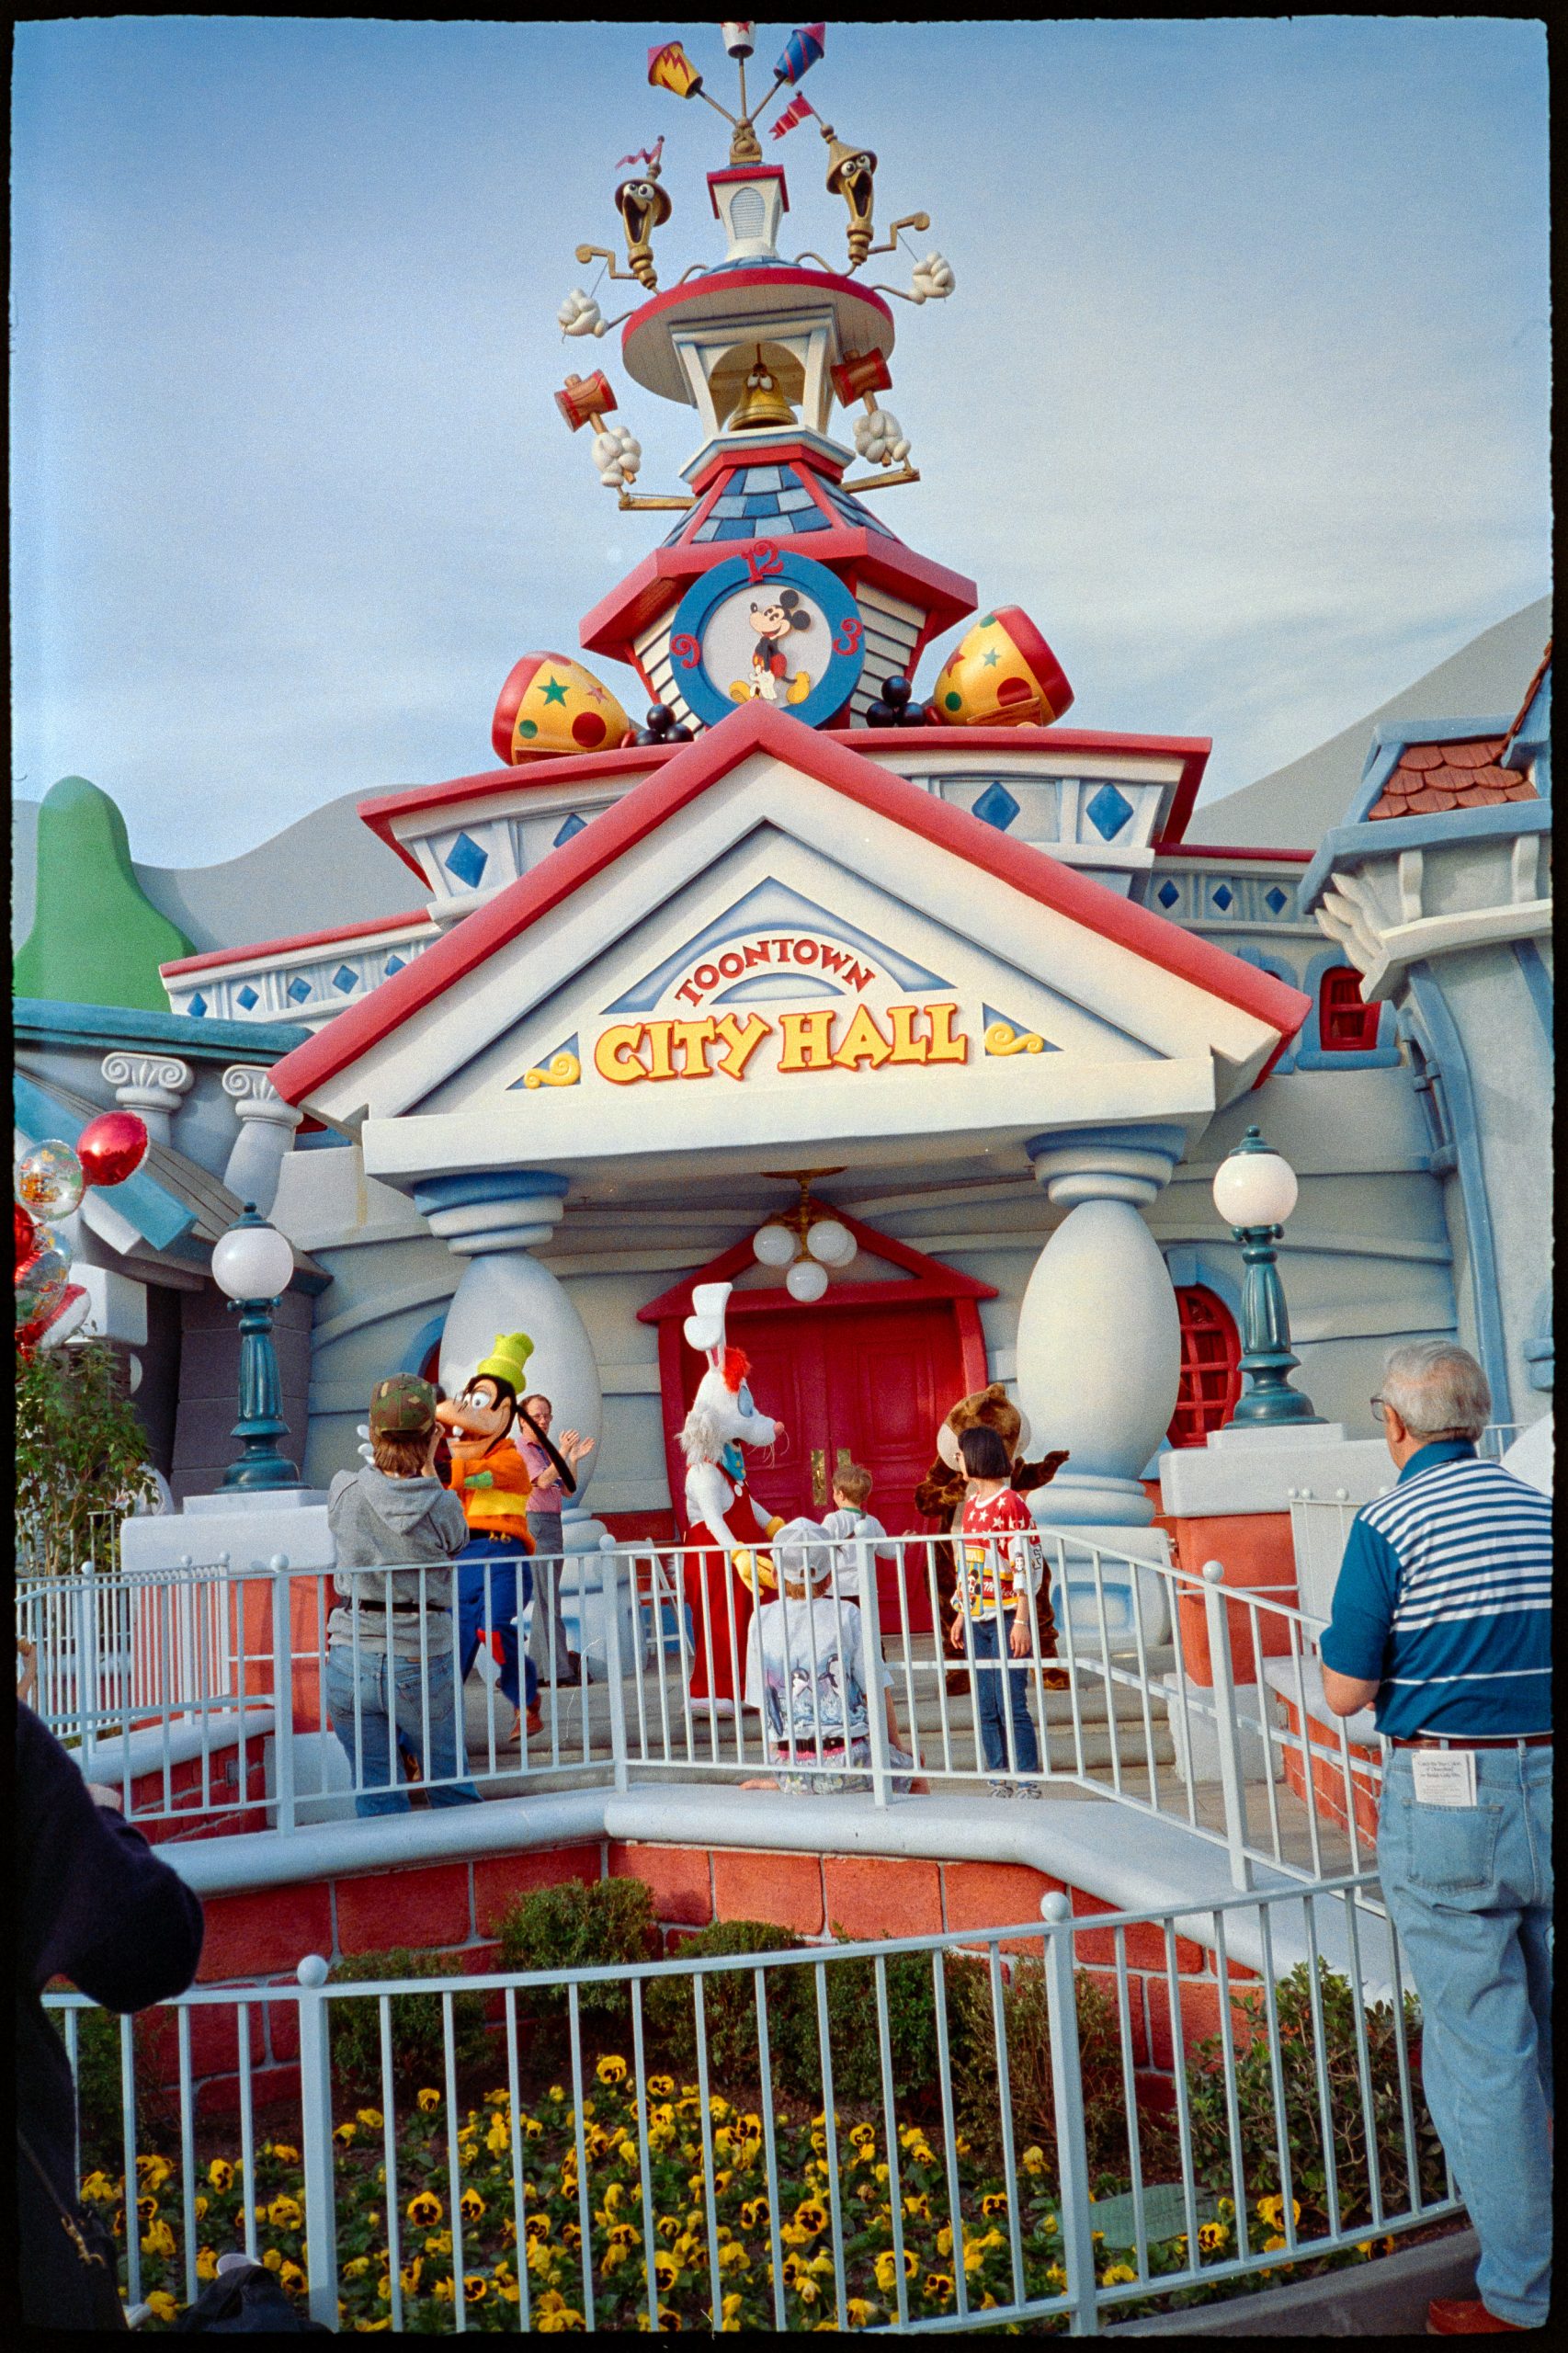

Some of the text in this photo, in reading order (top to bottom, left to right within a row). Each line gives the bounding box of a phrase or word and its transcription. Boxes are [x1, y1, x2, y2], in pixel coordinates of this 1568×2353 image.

[741, 540, 784, 583] 12
[670, 633, 701, 669] 9
[832, 618, 863, 655] 3
[674, 938, 876, 1007] TOONTOWN
[594, 1004, 968, 1086] CITY HALL
